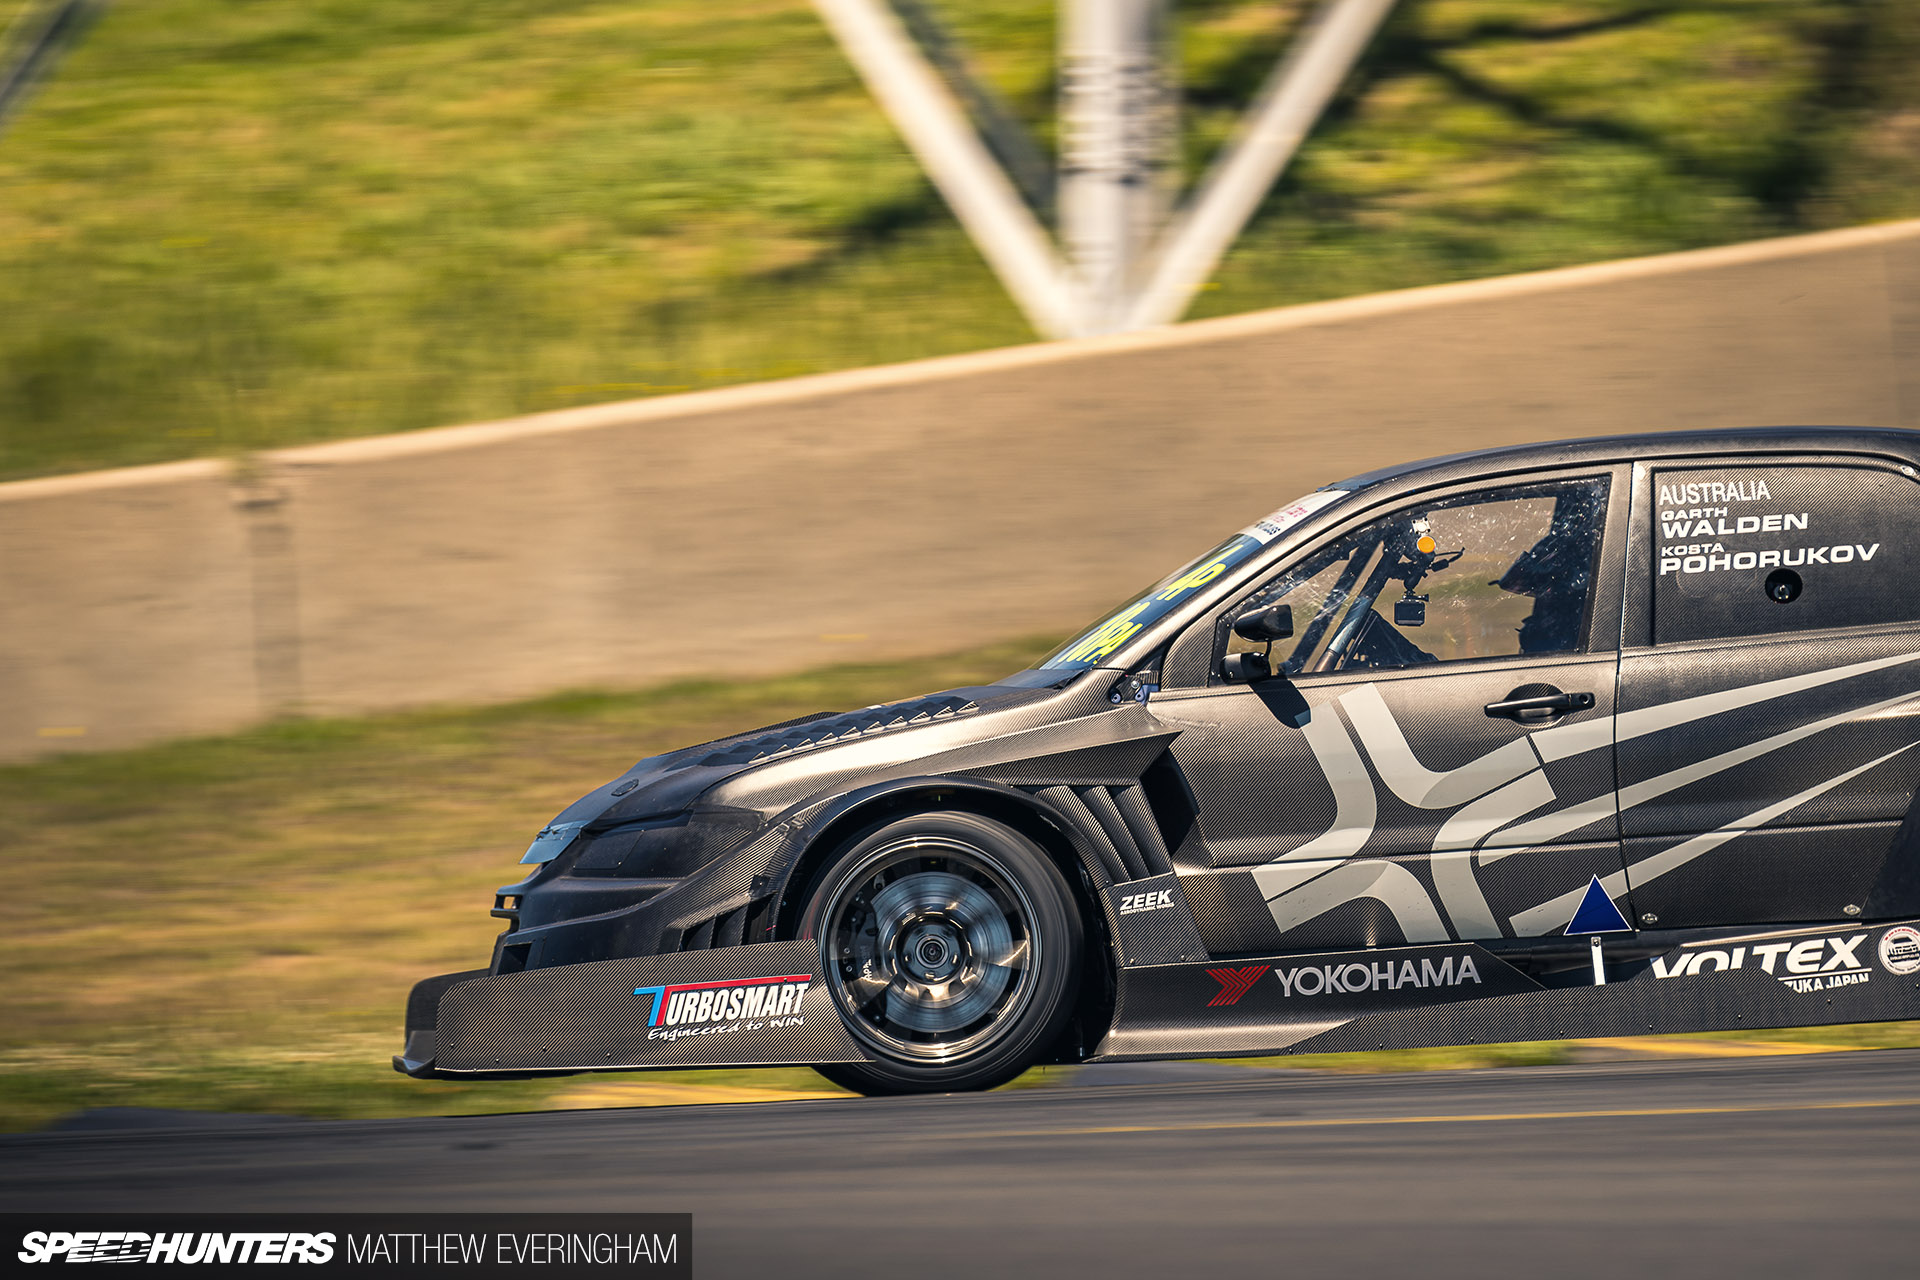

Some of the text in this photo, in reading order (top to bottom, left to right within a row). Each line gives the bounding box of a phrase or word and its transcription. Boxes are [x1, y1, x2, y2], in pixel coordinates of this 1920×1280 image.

[1659, 480, 1772, 505] AUSTRALIA
[1661, 507, 1728, 521] GARTH
[1662, 513, 1808, 539] WALDEN
[1660, 543, 1880, 576] POHORUKOV
[1661, 543, 1725, 557] KOSTA
[1120, 889, 1173, 911] ZEEK
[1275, 955, 1482, 998] YOKOHAMA
[1825, 972, 1869, 990] JAPAN
[633, 973, 812, 1027] TURBOSMART
[647, 1015, 805, 1041] Engineered to WIN
